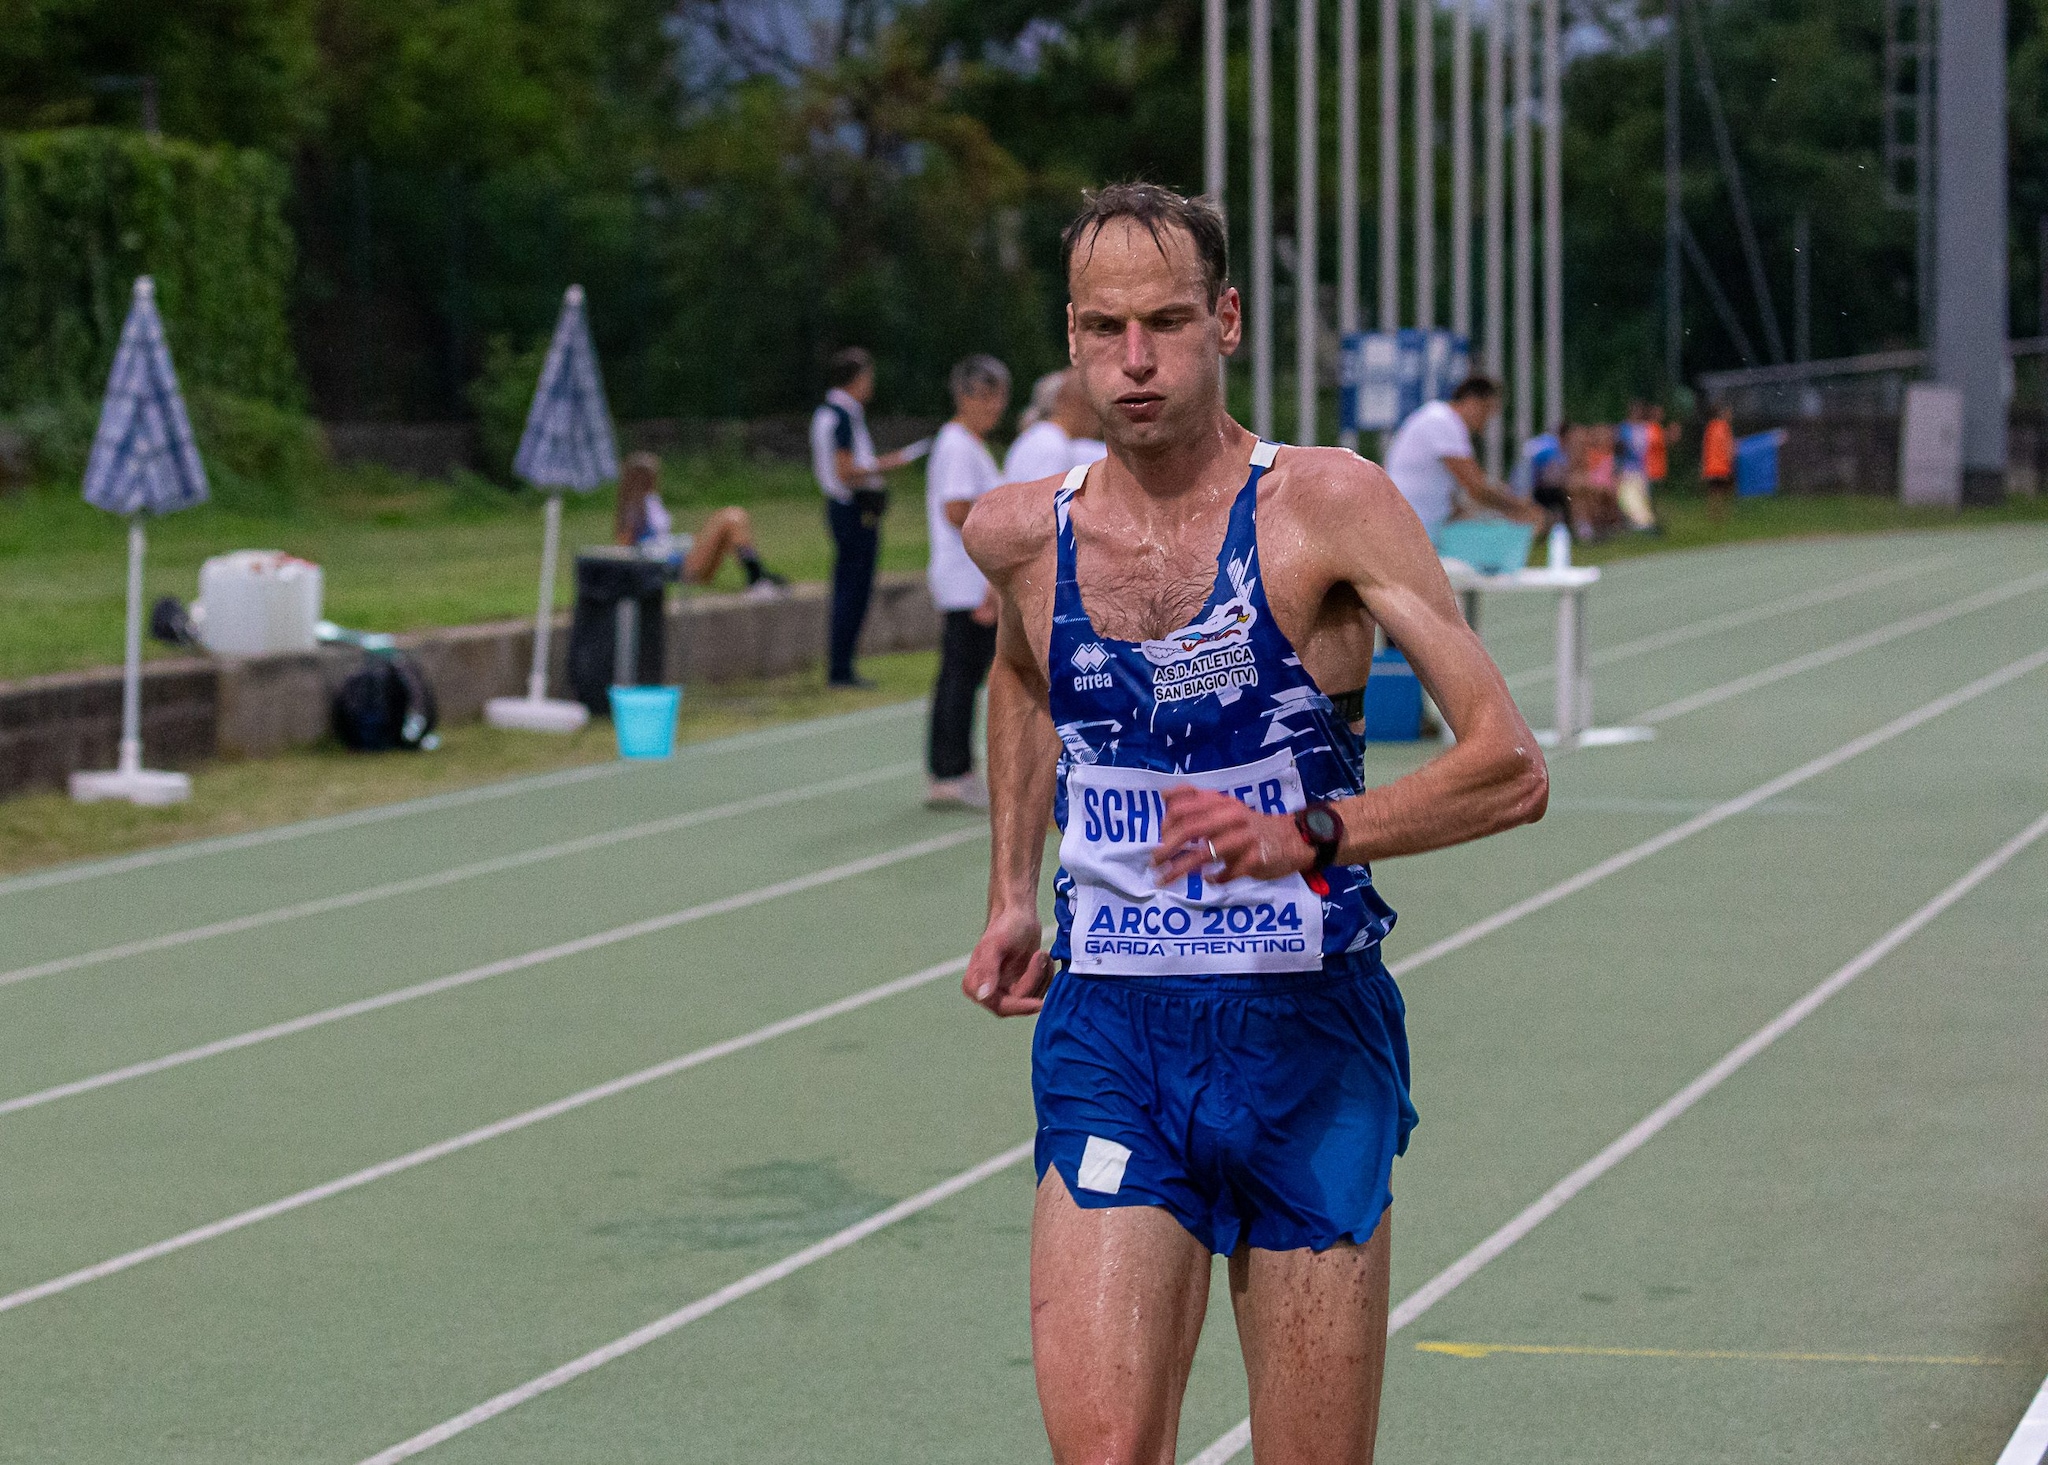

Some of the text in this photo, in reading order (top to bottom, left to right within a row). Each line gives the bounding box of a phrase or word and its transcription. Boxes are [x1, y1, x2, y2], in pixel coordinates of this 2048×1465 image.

[1155, 649, 1254, 683] A.S.D. ATLETICA
[1156, 667, 1258, 701] SAN BIAGIO (TV)
[1088, 902, 1303, 935] ARCO 2024
[1085, 938, 1305, 956] GARDA TRENTINO
